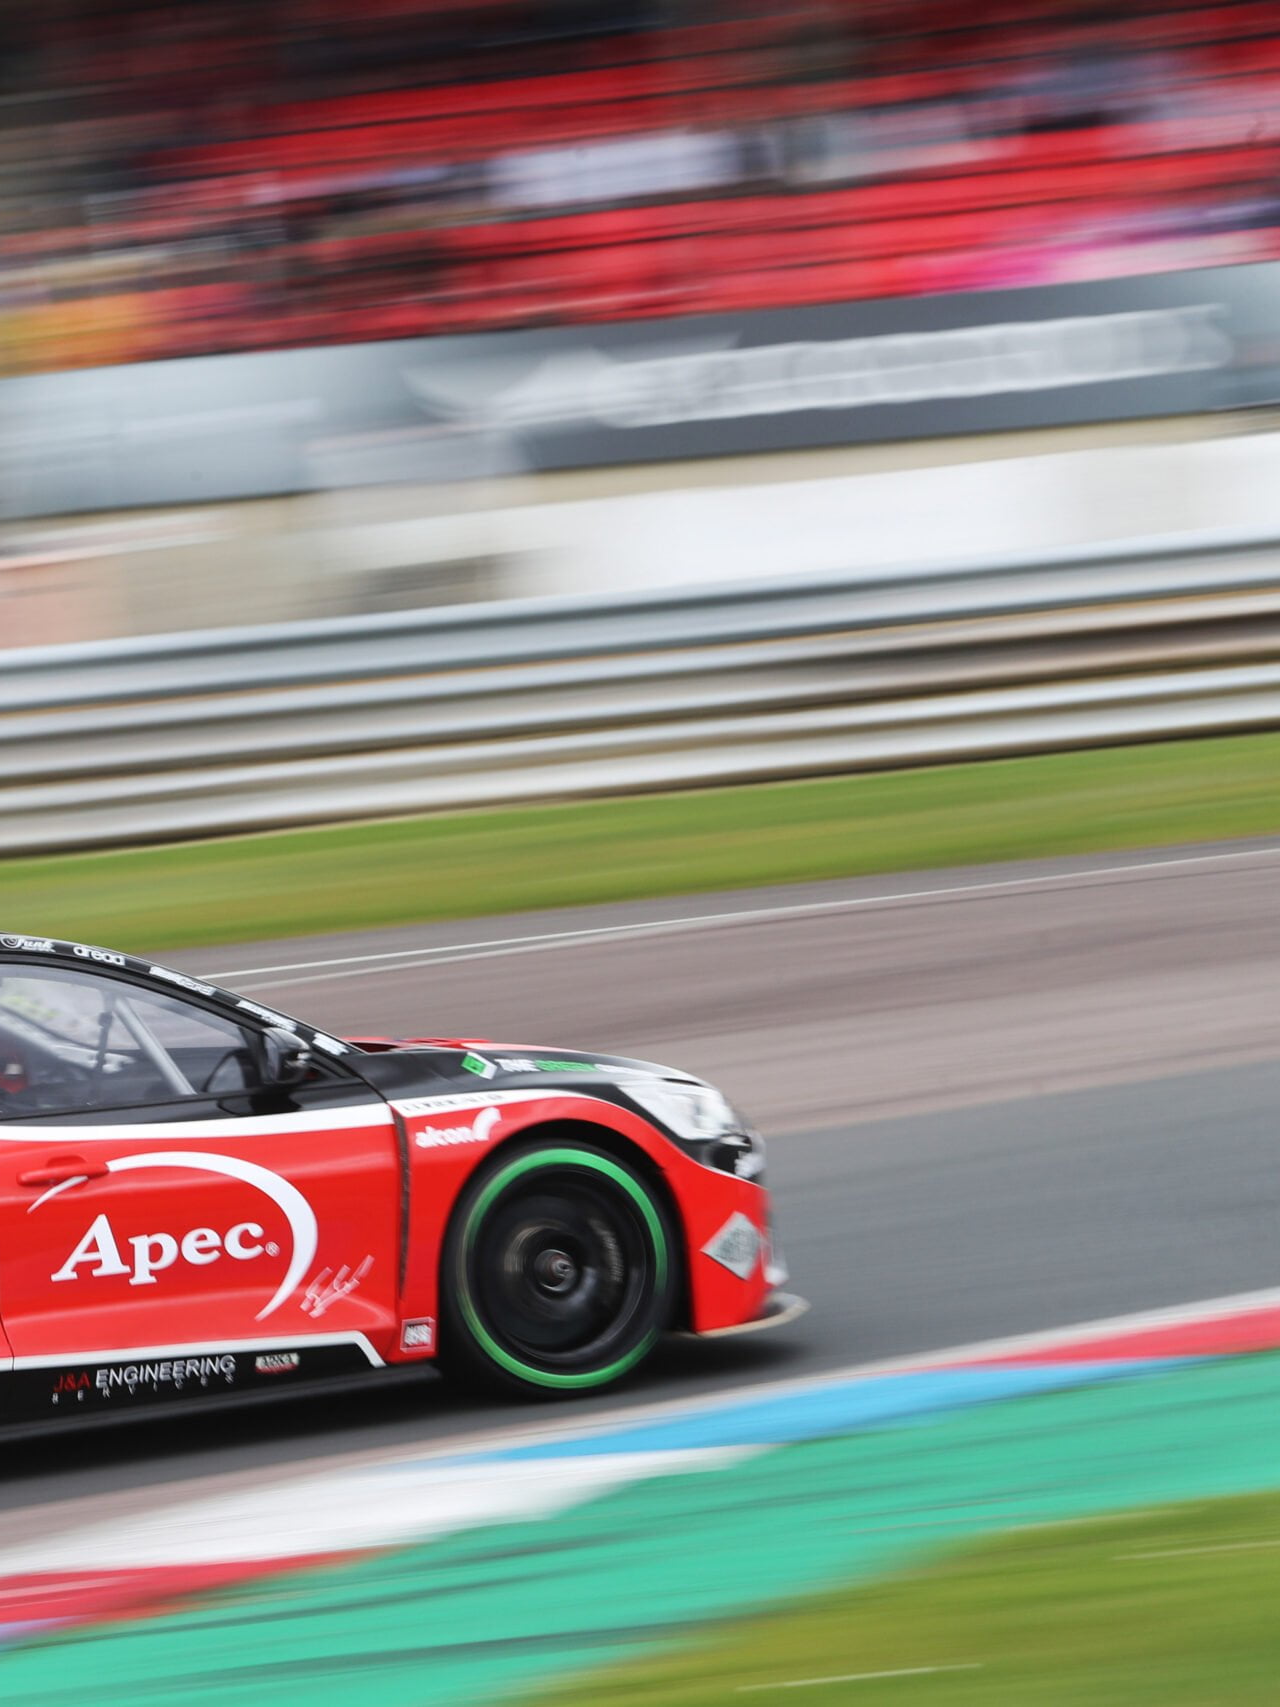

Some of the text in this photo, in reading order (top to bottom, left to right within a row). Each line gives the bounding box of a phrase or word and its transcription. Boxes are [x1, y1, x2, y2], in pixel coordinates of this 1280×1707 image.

[51, 1213, 265, 1286] Apec
[53, 1371, 92, 1393] J&A
[95, 1354, 237, 1390] ENGINEERING
